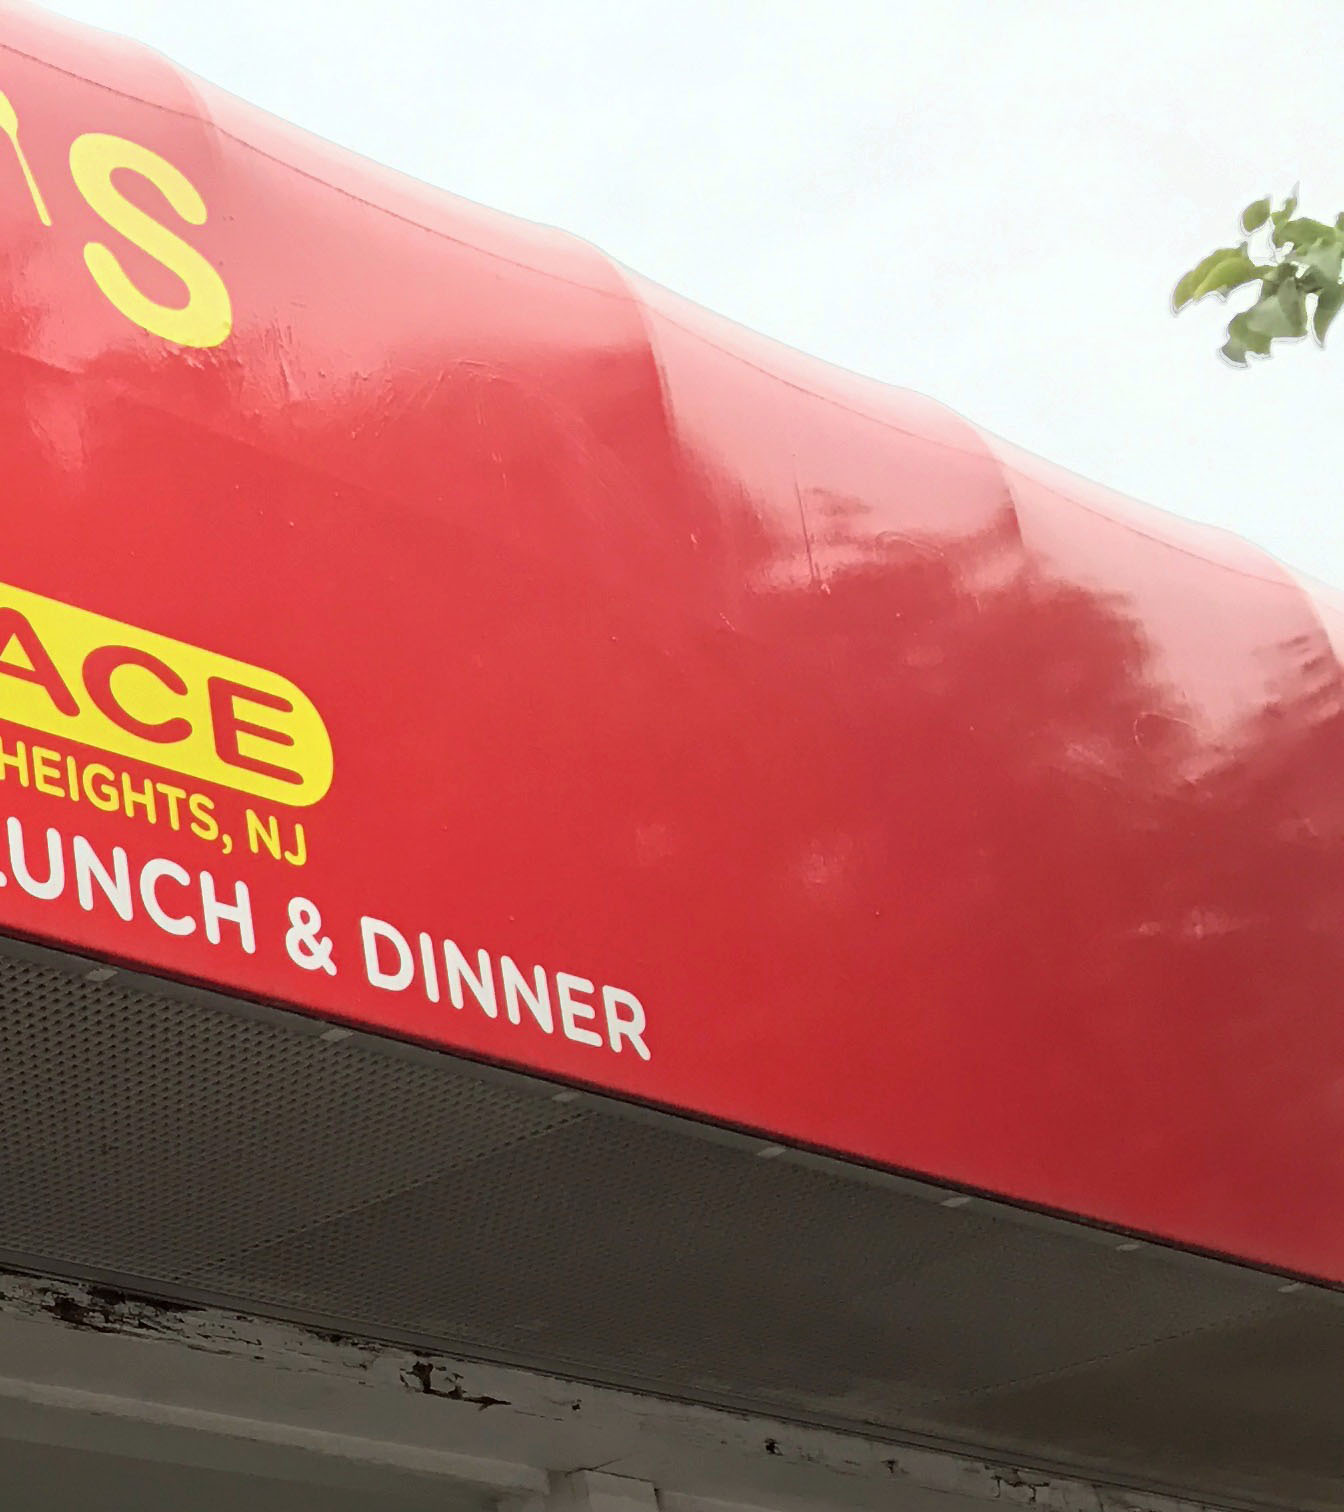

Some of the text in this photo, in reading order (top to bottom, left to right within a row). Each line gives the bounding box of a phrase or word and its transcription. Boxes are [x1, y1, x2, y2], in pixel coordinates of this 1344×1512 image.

[246, 810, 307, 866] NJ
[285, 897, 337, 976] &
[360, 916, 650, 1060] DINNER
